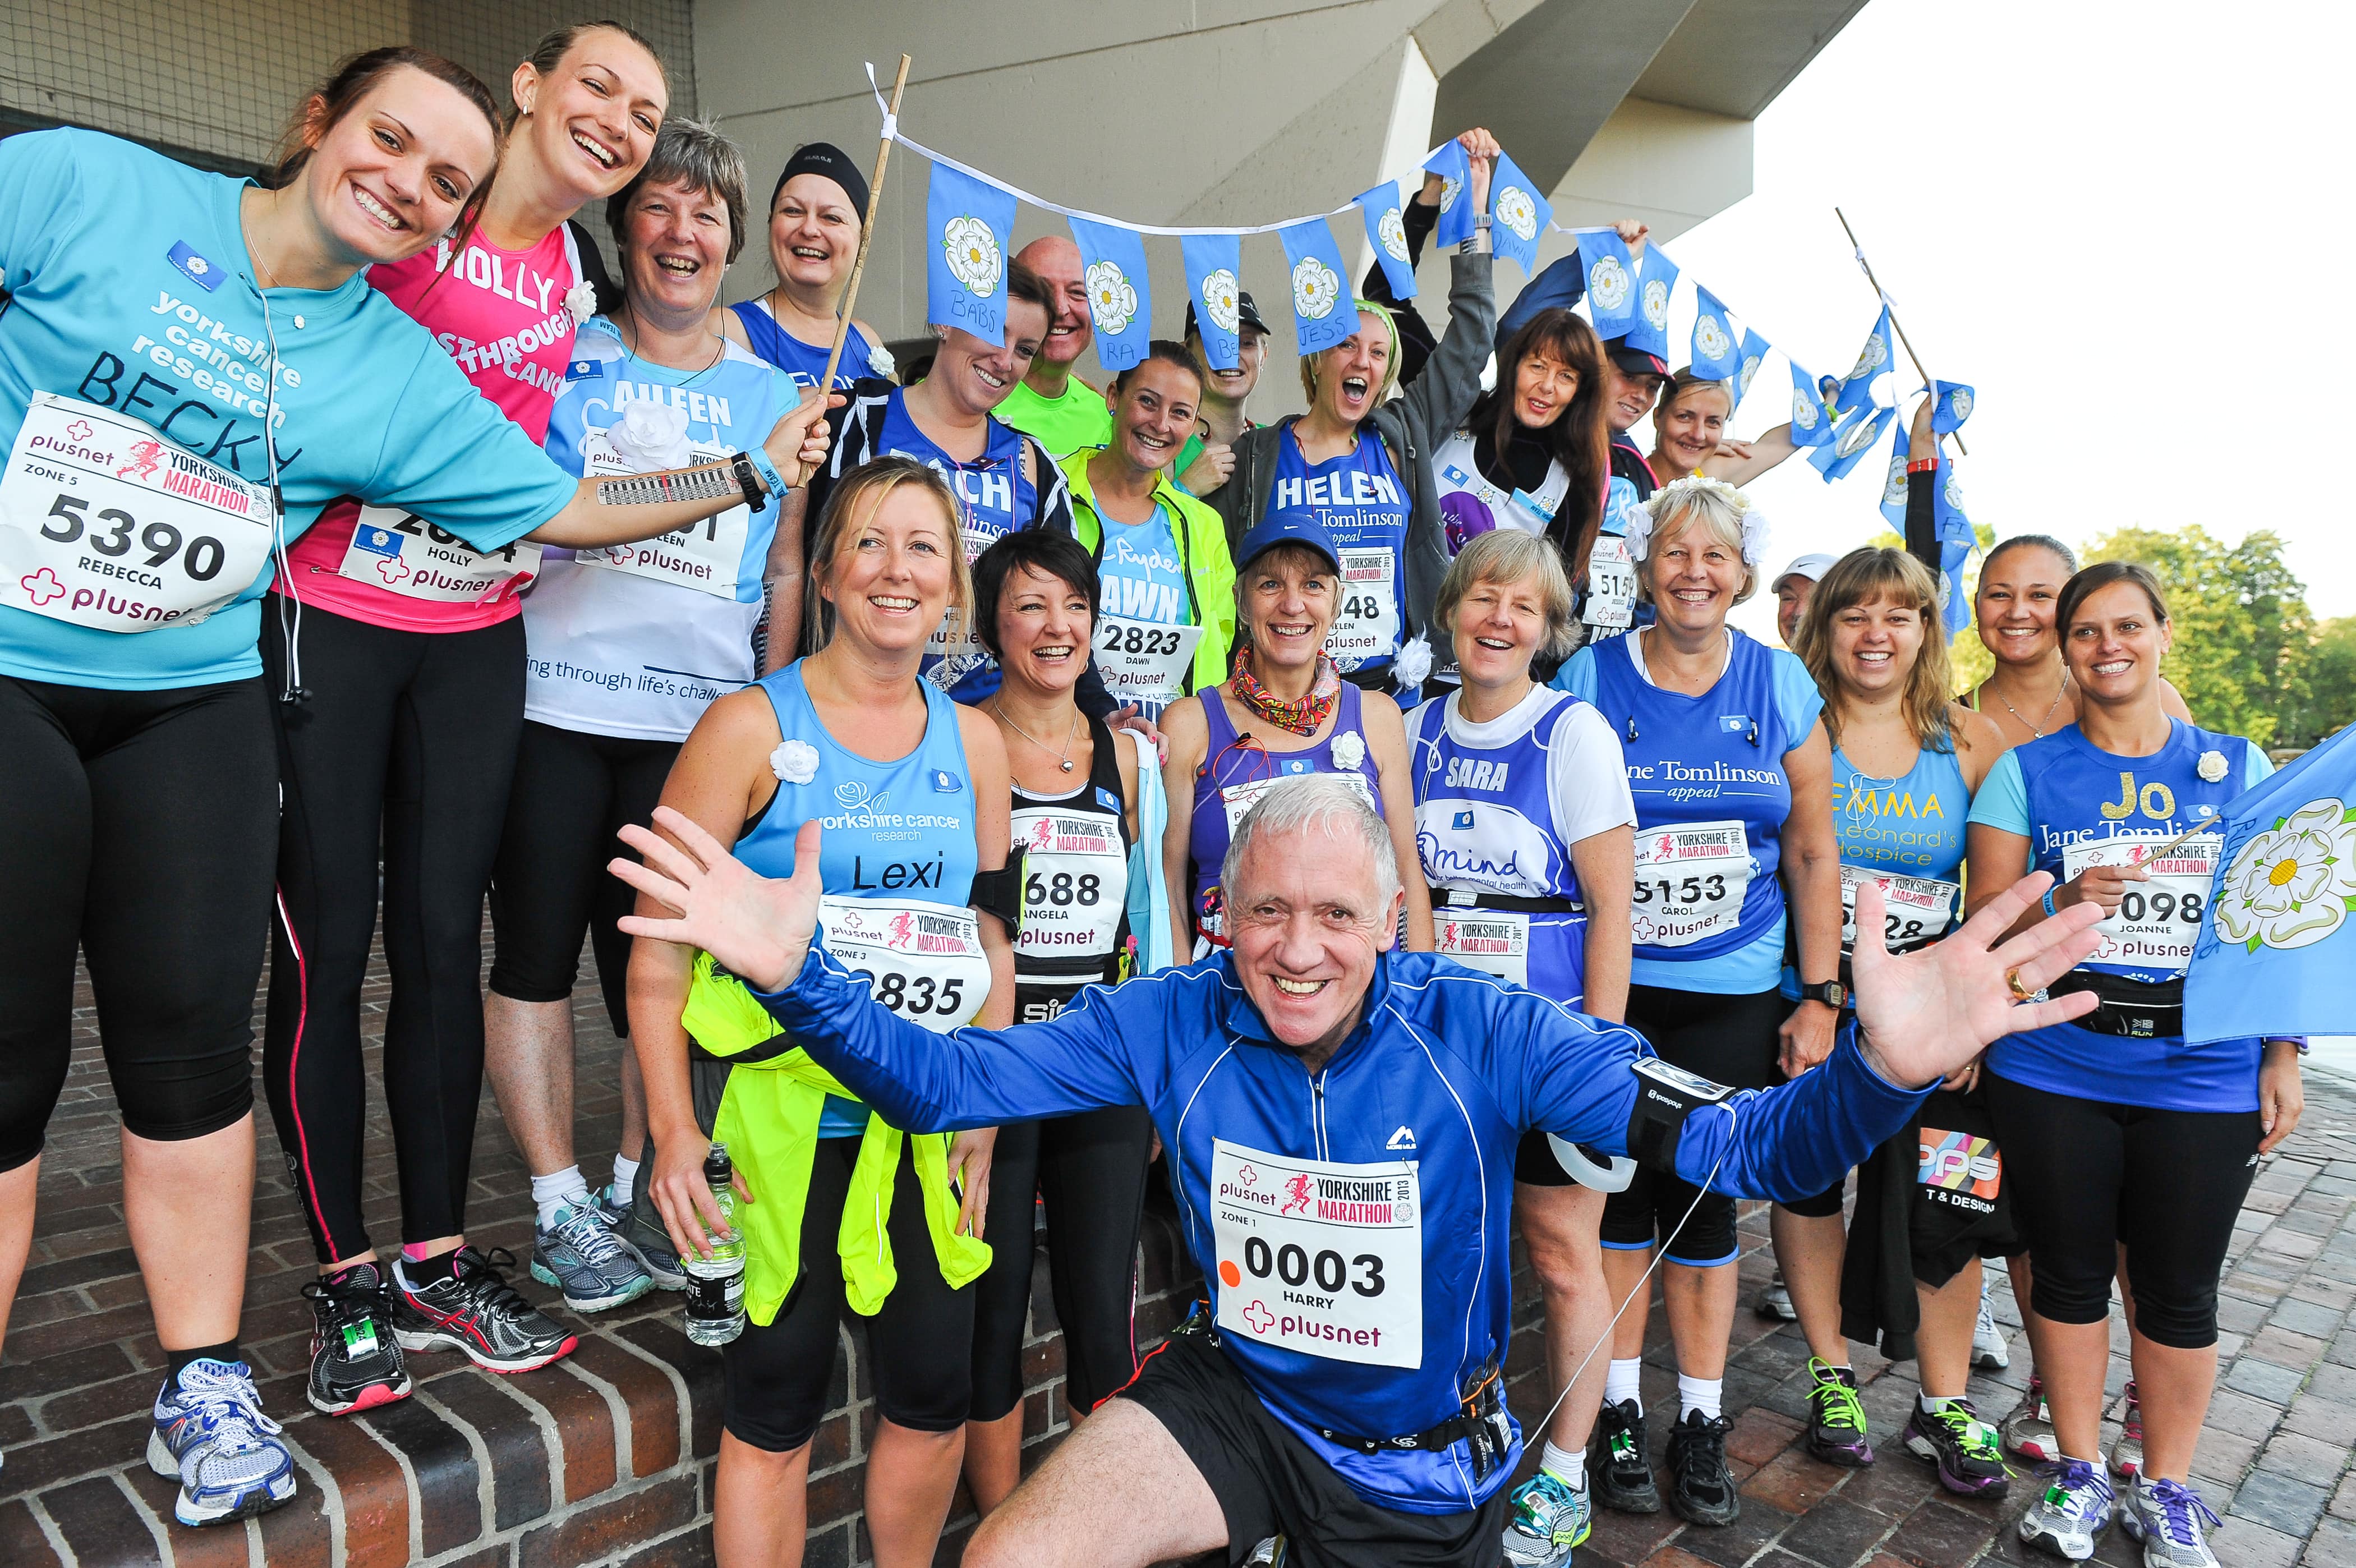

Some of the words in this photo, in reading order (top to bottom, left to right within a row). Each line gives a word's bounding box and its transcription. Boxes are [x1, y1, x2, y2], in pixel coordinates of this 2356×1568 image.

[435, 238, 555, 315] HOLLY
[951, 290, 996, 333] BABS
[150, 291, 302, 388] yorkshire
[457, 308, 573, 374] THROUGH
[1299, 316, 1345, 346] JESS
[165, 325, 279, 396] cancer
[131, 333, 287, 428] research
[30, 434, 116, 467] plusnet
[24, 464, 67, 484] ZONE
[68, 475, 78, 486] 5
[170, 452, 249, 496] YORKSHIRE
[765, 469, 780, 489] TEAM
[163, 470, 249, 514] MARATHON
[1277, 470, 1401, 511] HELEN
[1315, 507, 1403, 528] Tomlinson
[40, 493, 225, 581] 5390
[427, 546, 473, 567] HOLLY
[638, 549, 712, 581] plusnet
[1346, 557, 1382, 569] YORKSHIRE
[78, 556, 163, 590] REBECCA
[412, 569, 495, 592] plusnet
[1346, 568, 1381, 581] MARATHON
[71, 587, 193, 624] plusnet
[1102, 624, 1181, 656] 2823
[1326, 636, 1377, 651] plusnet
[1125, 656, 1150, 666] DAWN
[555, 661, 632, 691] through
[637, 674, 675, 696] life's
[1118, 671, 1166, 686] plusnet
[1444, 756, 1509, 792] SARA
[1658, 760, 1781, 787] Tomlinson
[1667, 784, 1720, 803] appeal
[1832, 783, 1944, 819] EMMA
[906, 813, 960, 830] cancer
[1056, 820, 1105, 837] YORKSHIRE
[871, 829, 922, 842] research
[1057, 836, 1107, 852] MARATHON
[1677, 833, 1728, 846] YORKSHIRE
[1833, 820, 1957, 849] Leonard's
[2039, 824, 2095, 854] Jane
[2099, 820, 2226, 838] Tomli
[1678, 845, 1729, 858] MARATHON
[853, 850, 944, 890] Lexi
[1433, 849, 1526, 880] mind
[2150, 860, 2207, 873] MARATHON
[1025, 872, 1101, 906] 688
[1499, 879, 1527, 890] health
[1633, 874, 1726, 904] 5153
[1894, 879, 1940, 896] YORKSHIRE
[1024, 909, 1069, 919] ANGELA
[1662, 907, 1695, 916] CAROL
[2105, 892, 2203, 923] 098
[831, 927, 882, 941] plusnet
[917, 914, 961, 938] YORKSHIRE
[964, 924, 972, 940] 2013
[1020, 928, 1095, 948] plusnet
[1461, 924, 1510, 939] YORKSHIRE
[1658, 913, 1720, 940] plusnet
[2120, 926, 2172, 934] JOANNE
[830, 948, 858, 959] ZONE
[917, 934, 967, 953] MARATHON
[1461, 939, 1508, 953] MARATHON
[1220, 1182, 1276, 1206] plusnet
[1317, 1178, 1392, 1202] YORKSHIRE
[1397, 1180, 1409, 1201] 2013
[1926, 1189, 1935, 1199] T
[1938, 1192, 1948, 1202] &
[1951, 1194, 1995, 1214] DESIGN
[1221, 1210, 1249, 1225] ZONE
[1253, 1218, 1257, 1227] 1
[1317, 1199, 1392, 1223] MARATHON
[1244, 1236, 1386, 1298] 0003
[1283, 1290, 1335, 1310] HARRY
[1281, 1315, 1381, 1347] plusnet
